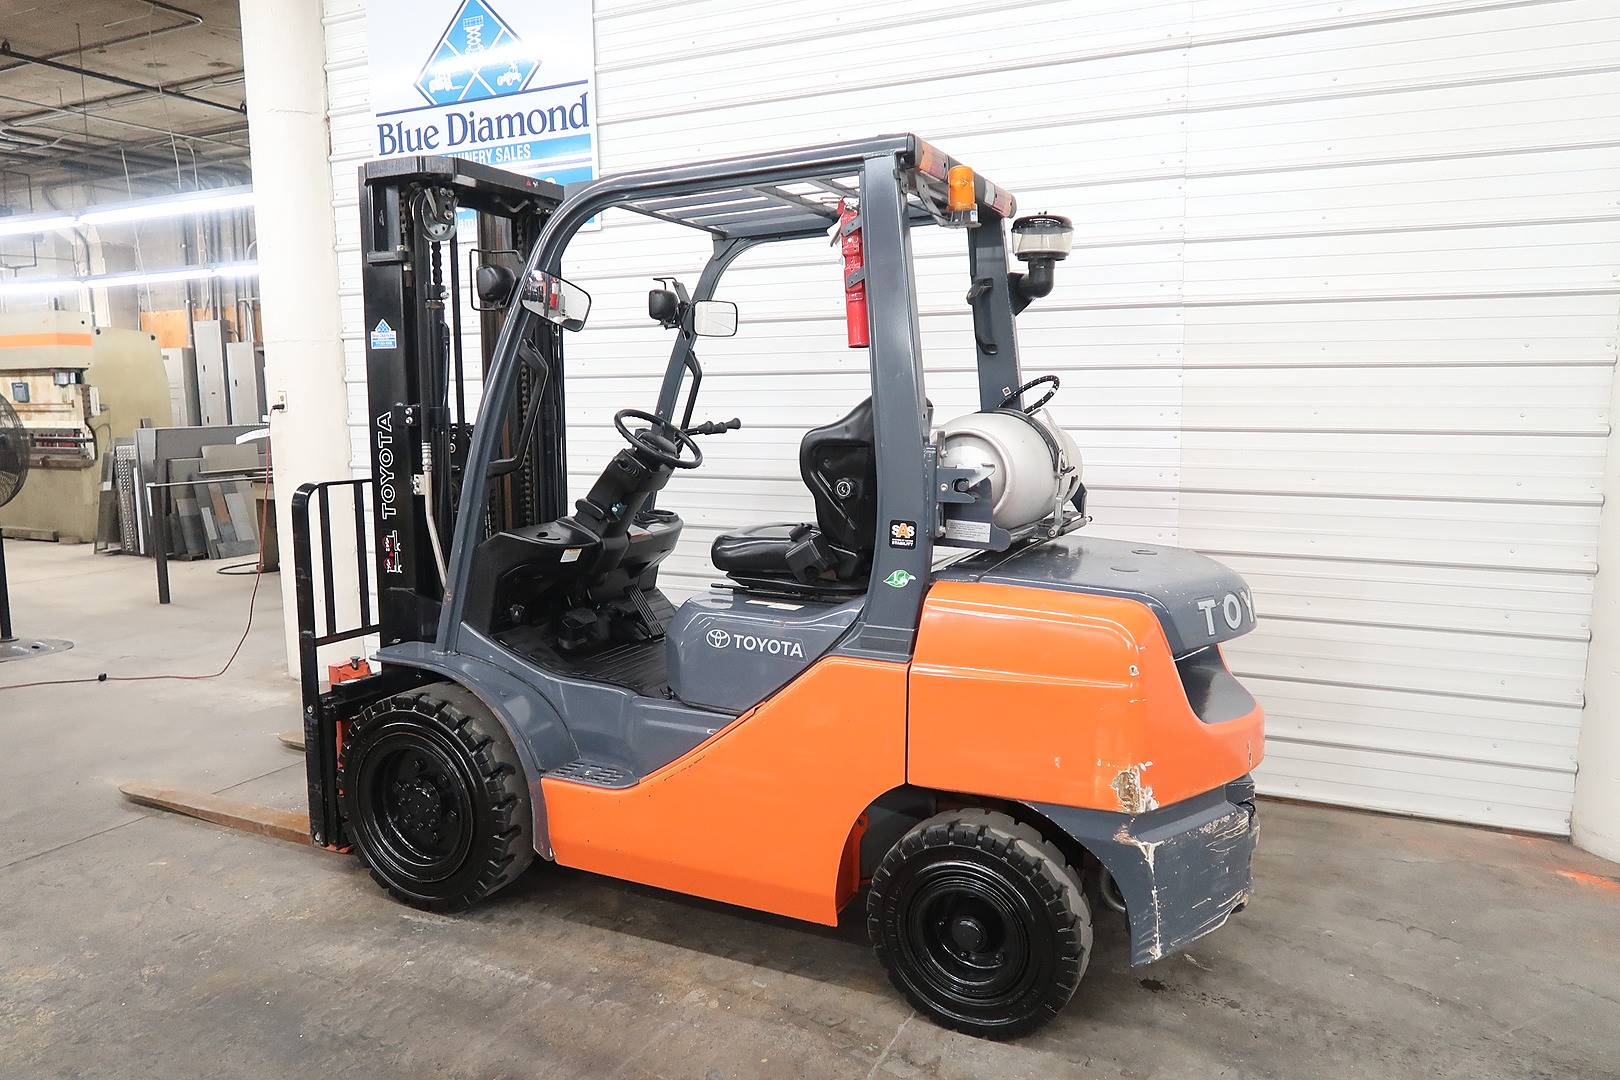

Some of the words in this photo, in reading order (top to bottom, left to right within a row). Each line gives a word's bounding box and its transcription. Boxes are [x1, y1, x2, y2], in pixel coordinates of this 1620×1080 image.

[377, 121, 440, 156] Blue
[445, 91, 590, 147] Diamond
[495, 143, 532, 163] SALES
[377, 411, 397, 520] TOYOTA
[891, 522, 915, 539] SAS
[733, 634, 804, 658] TOYOTA
